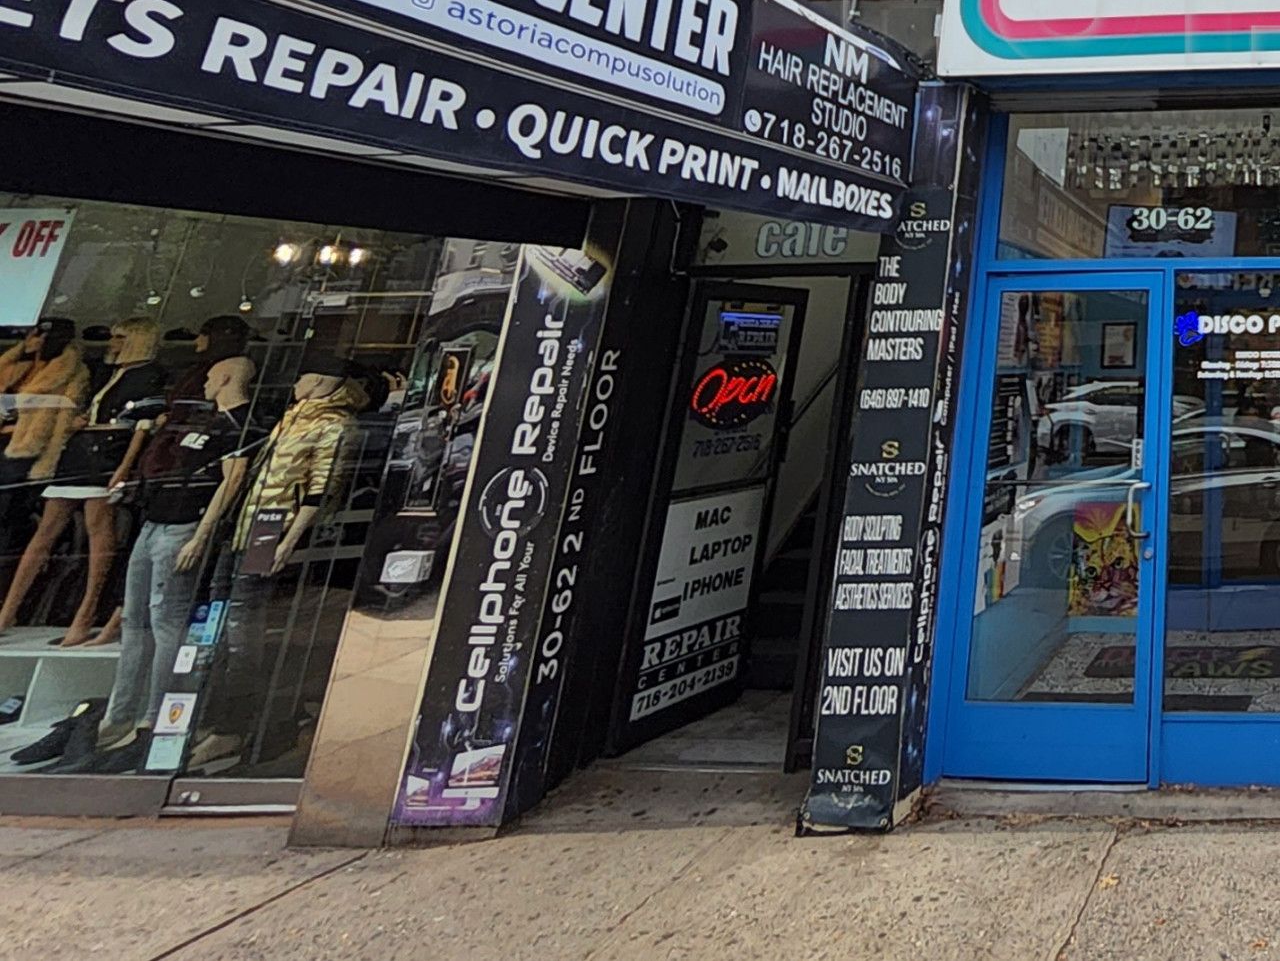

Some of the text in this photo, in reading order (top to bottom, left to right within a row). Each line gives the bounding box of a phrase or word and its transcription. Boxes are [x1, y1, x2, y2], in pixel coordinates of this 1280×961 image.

[822, 34, 869, 83] NM
[758, 41, 908, 130] HAIR REPLACEMENT
[201, 17, 467, 130] REPAIR
[507, 103, 650, 172] QUICK
[658, 139, 760, 193] PRINT
[777, 167, 893, 220] MAILBOXES
[811, 99, 867, 142] STUDIO
[762, 111, 902, 179] 718-267-2516
[897, 219, 950, 232] ATCHED
[1131, 206, 1214, 231] 30-62
[12, 219, 66, 258] OFF
[879, 255, 901, 278] THE
[874, 282, 907, 305] BODY
[870, 308, 945, 333] CONTOURING
[1197, 314, 1265, 335] DISCO
[561, 338, 579, 377] Needs
[866, 337, 924, 361] MASTERS
[551, 379, 570, 418] Repair
[692, 366, 777, 415] Open
[860, 388, 930, 410] (646) 897-1410
[542, 421, 561, 462] Device
[850, 461, 926, 477] SNATCHED
[455, 313, 566, 712] Cellphone Repair
[536, 350, 622, 685] 30-62 2 ND FLOOR
[695, 506, 731, 530] MAC
[520, 541, 535, 566] Your
[689, 533, 752, 567] LAPTOP
[514, 572, 527, 592] All
[683, 567, 745, 602] IPHONE
[494, 617, 519, 683] Solutions
[641, 613, 742, 670] REPAIR
[827, 647, 905, 677] VISIT US ON
[821, 685, 899, 716] 2ND FLOOR
[816, 769, 892, 785] SNATCHED
